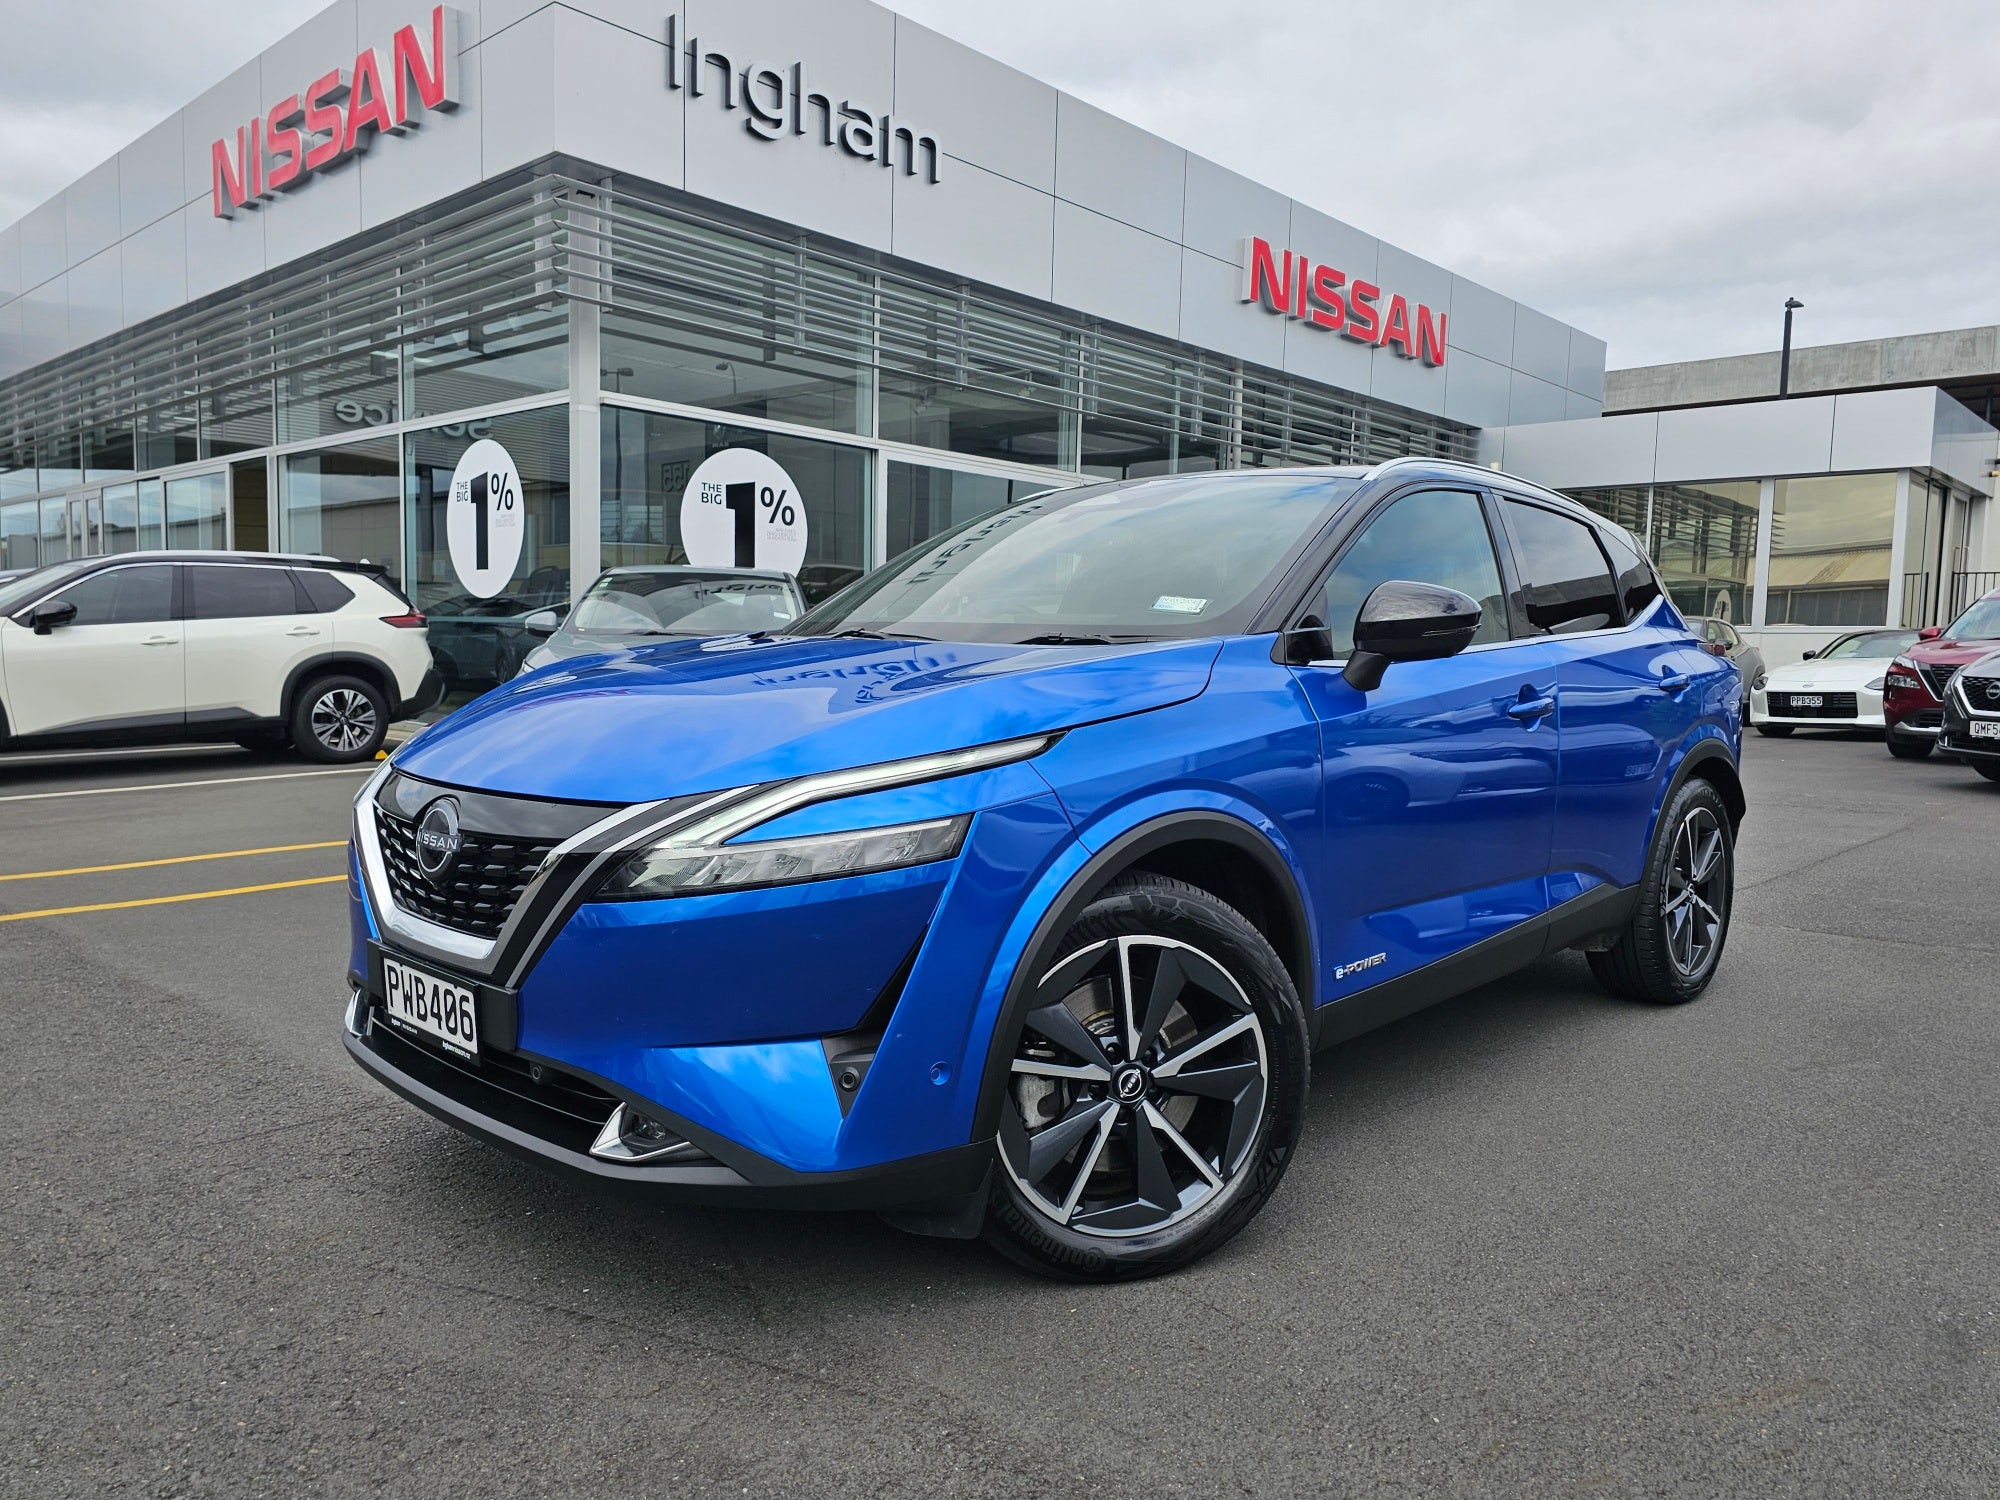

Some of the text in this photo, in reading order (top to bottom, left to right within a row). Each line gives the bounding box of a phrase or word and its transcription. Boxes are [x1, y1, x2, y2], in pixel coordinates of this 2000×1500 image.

[668, 14, 941, 184] Ingham
[212, 4, 450, 218] NISSAN
[1245, 236, 1447, 367] NISSAN
[456, 481, 468, 490] THE
[701, 482, 722, 493] THE
[456, 491, 469, 502] BIG
[701, 493, 722, 505] BIG
[1791, 696, 1822, 705] PPB355
[1974, 722, 2000, 736] QMF5
[1334, 952, 1387, 980] e-POWER
[387, 964, 474, 1043] PWB406
